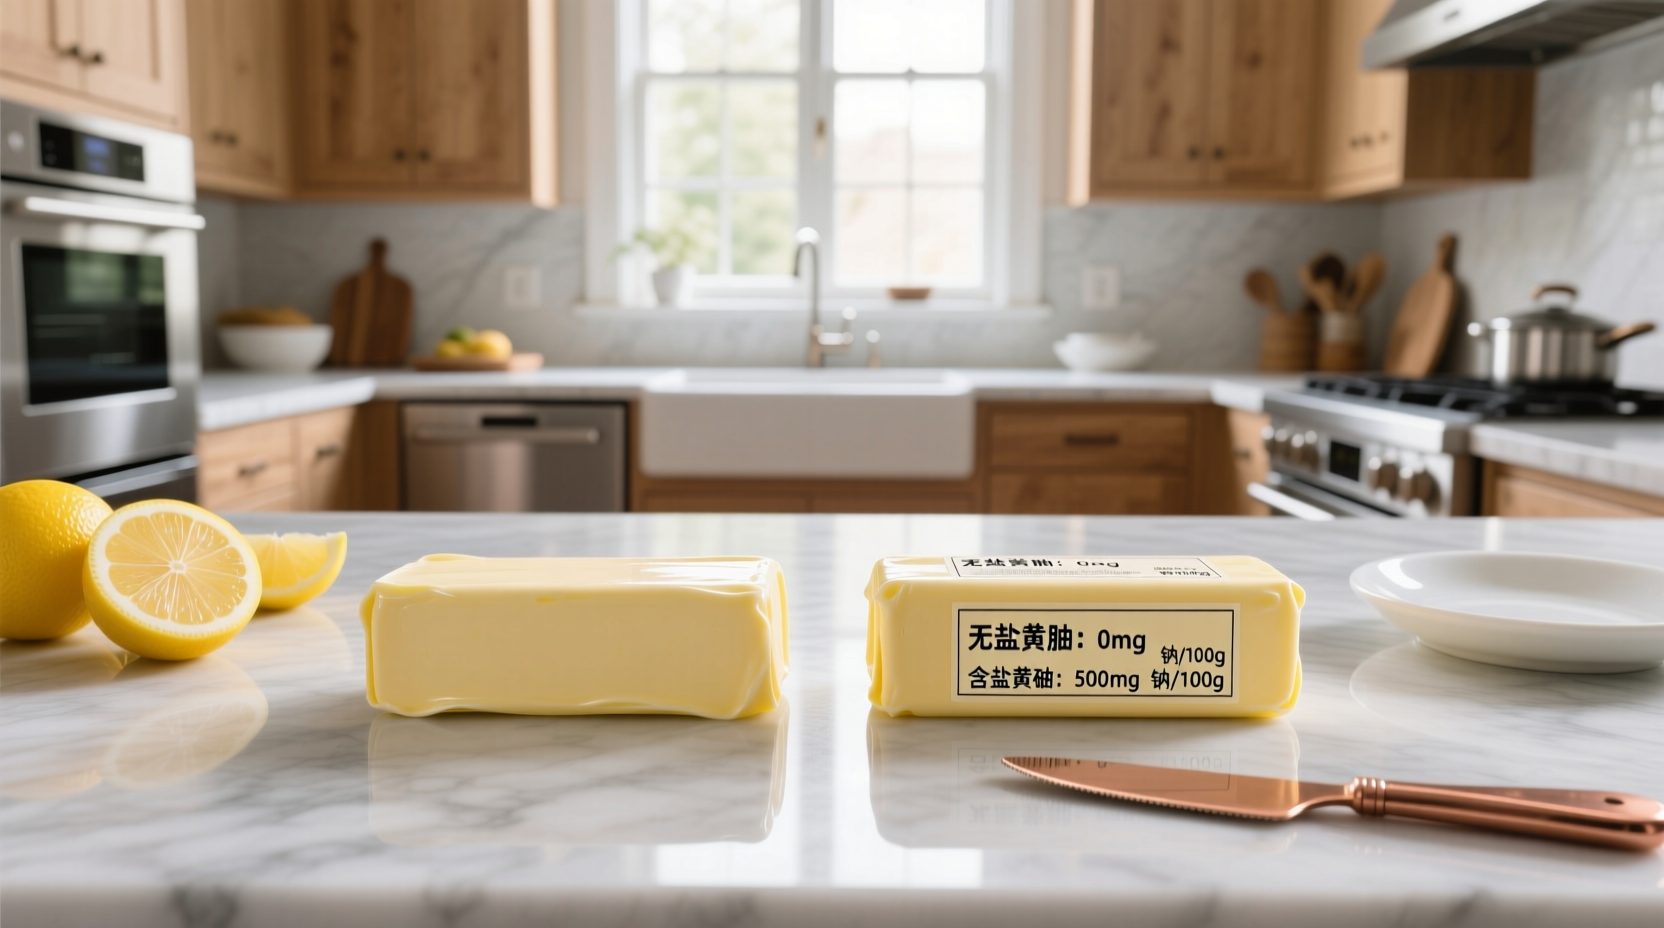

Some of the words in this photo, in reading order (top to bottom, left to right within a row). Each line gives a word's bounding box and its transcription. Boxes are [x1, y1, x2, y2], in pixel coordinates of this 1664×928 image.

[1097, 629, 1146, 655] 0mg
[1160, 644, 1226, 668] 钠/100g
[1074, 669, 1140, 693] 500mg
[1150, 668, 1224, 693] 钠/100g
